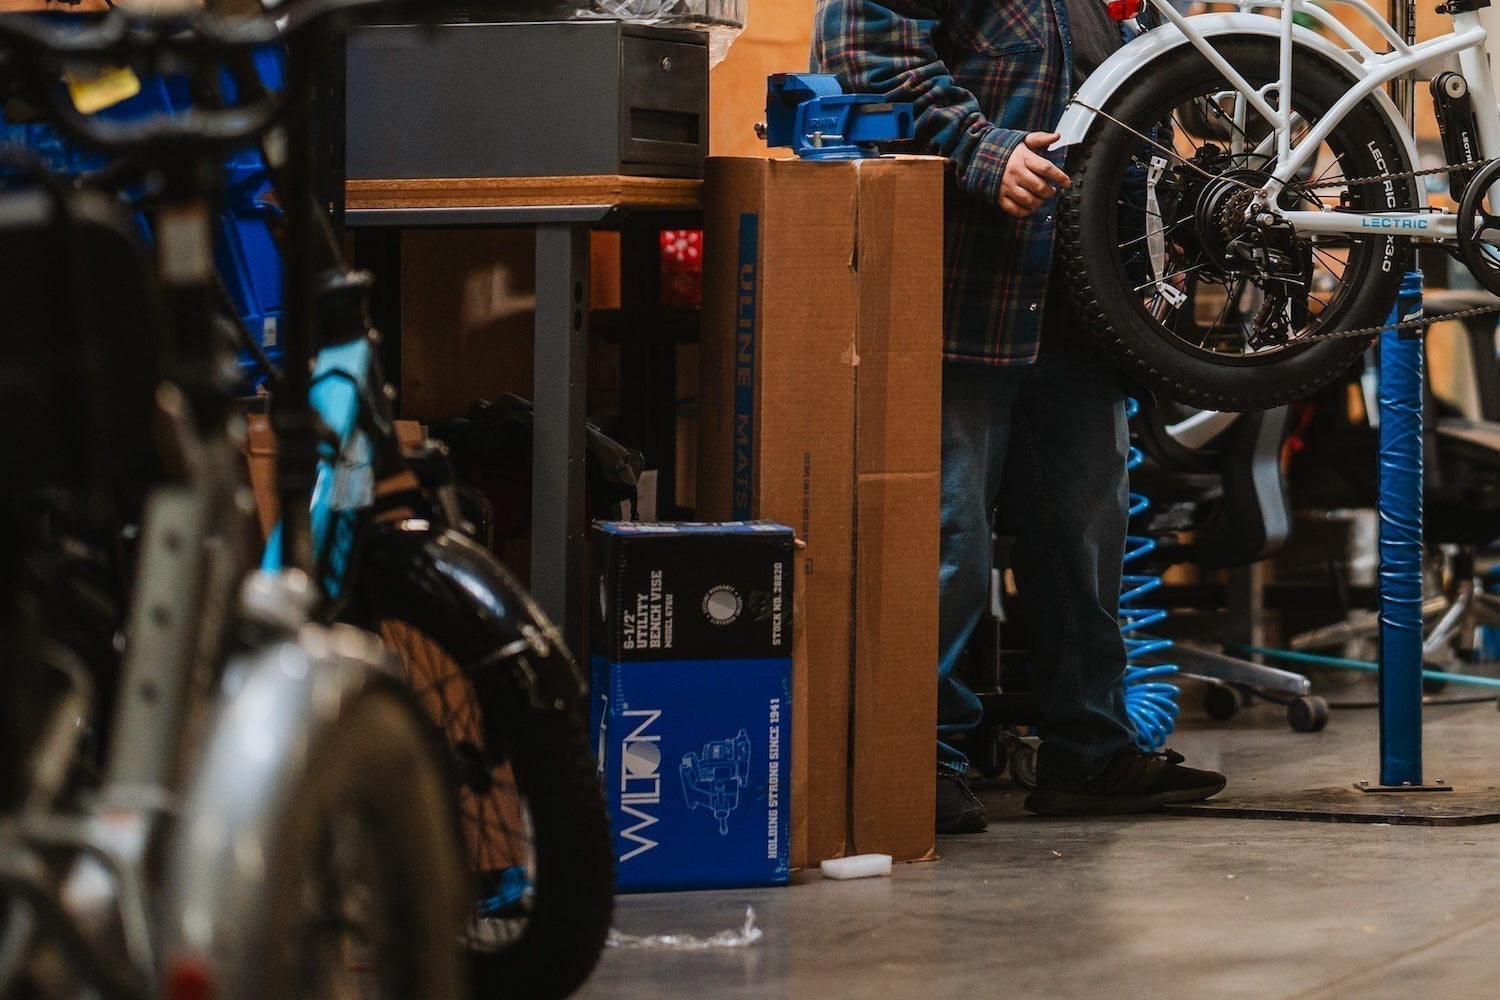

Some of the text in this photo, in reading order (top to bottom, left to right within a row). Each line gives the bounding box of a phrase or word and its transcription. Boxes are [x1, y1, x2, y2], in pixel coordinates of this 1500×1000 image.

[1366, 140, 1397, 209] LECTRIC
[1362, 218, 1429, 230] LECTRIC
[1382, 235, 1395, 273] x3.0
[736, 263, 754, 510] ULINE MATS
[624, 610, 635, 649] 6-1/2"
[637, 593, 649, 649] UTILITY
[650, 570, 663, 649] BENCH VISE
[664, 618, 673, 649] MODEL
[772, 612, 782, 646] STOCK
[619, 709, 662, 863] WILTON
[767, 698, 780, 859] HOLDING STRONG SINCE 1941
